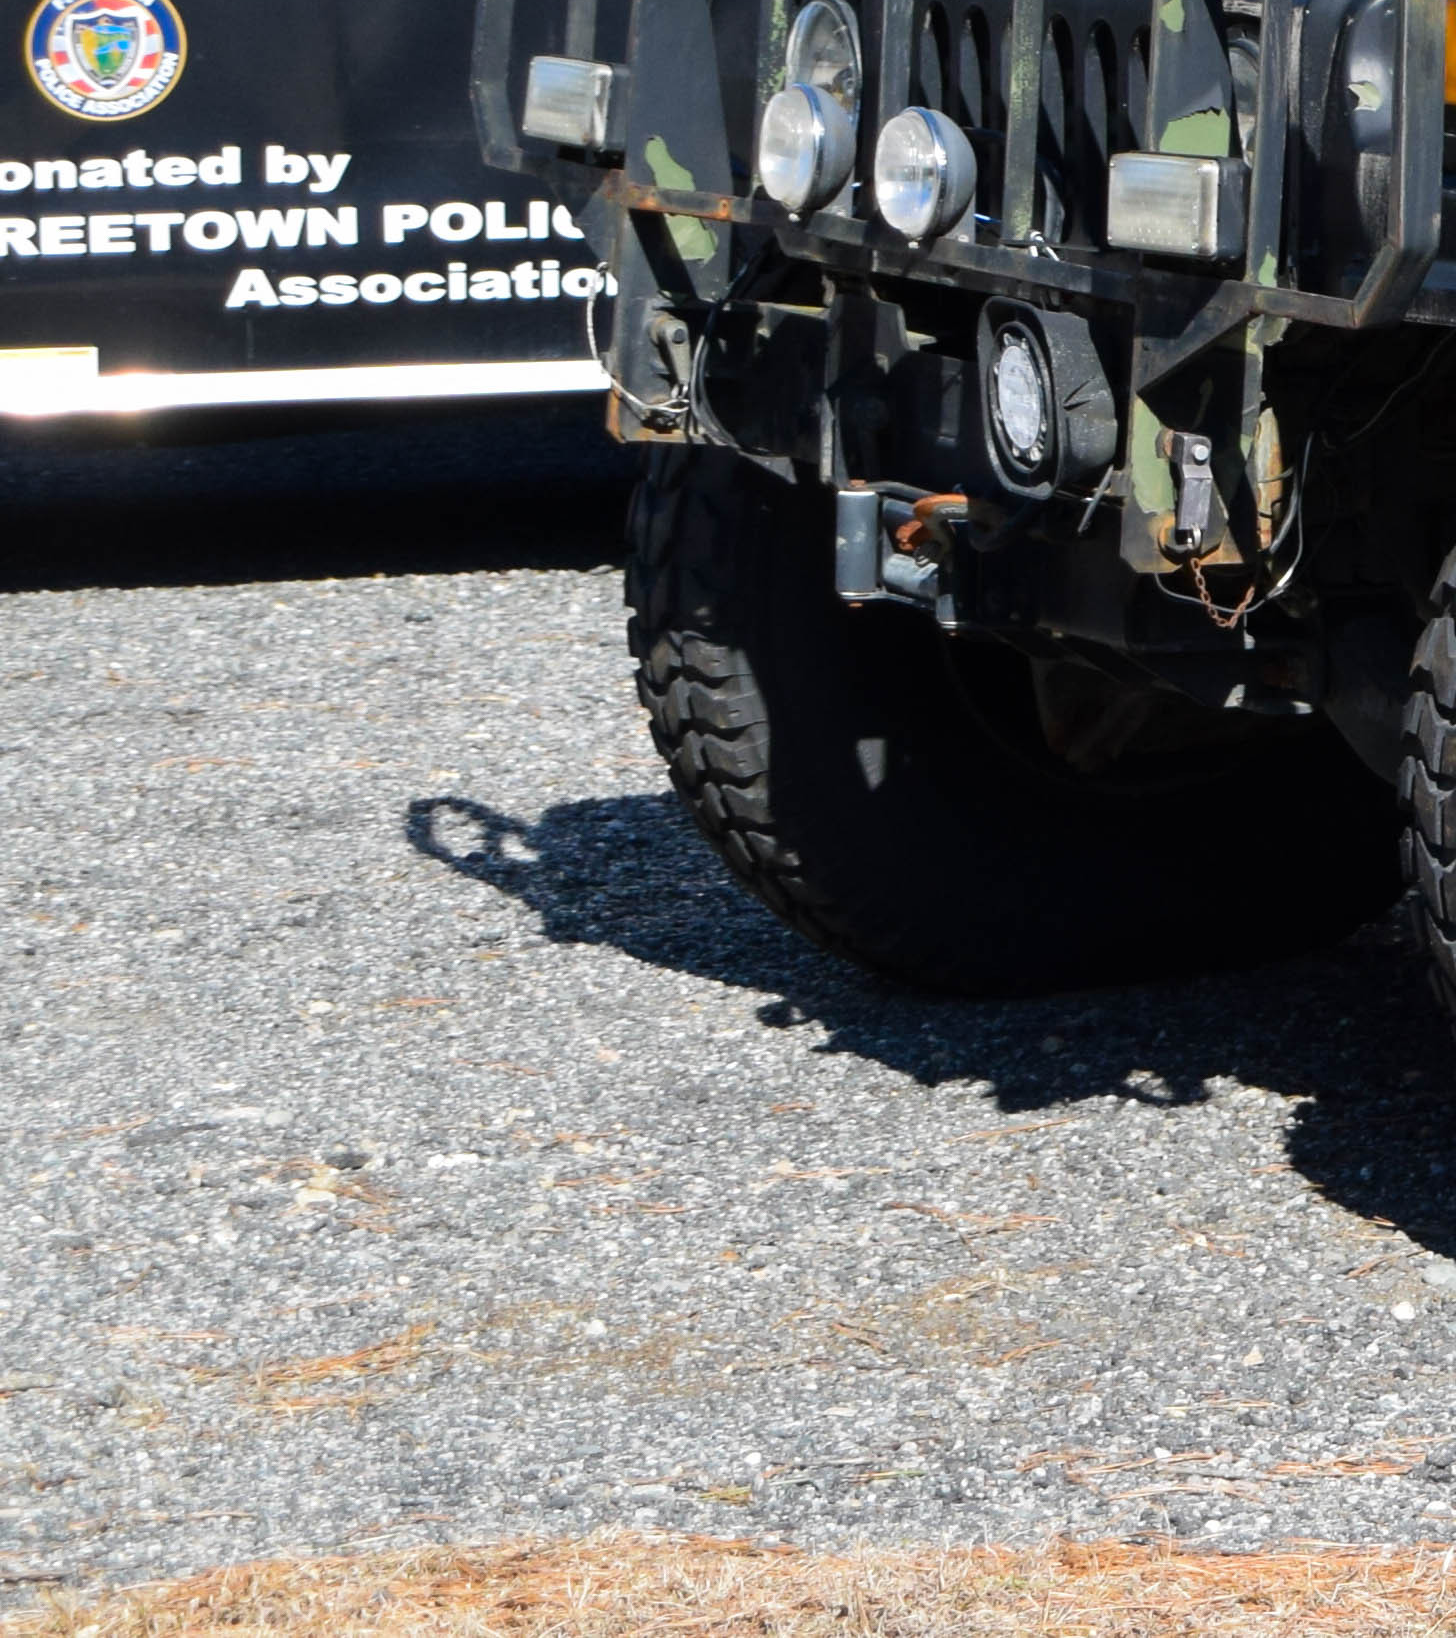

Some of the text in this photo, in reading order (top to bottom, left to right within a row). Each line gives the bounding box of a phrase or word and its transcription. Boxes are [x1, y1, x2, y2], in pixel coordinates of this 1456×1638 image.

[34, 51, 180, 116] POLICE ASSOCIATION
[264, 144, 353, 194] by
